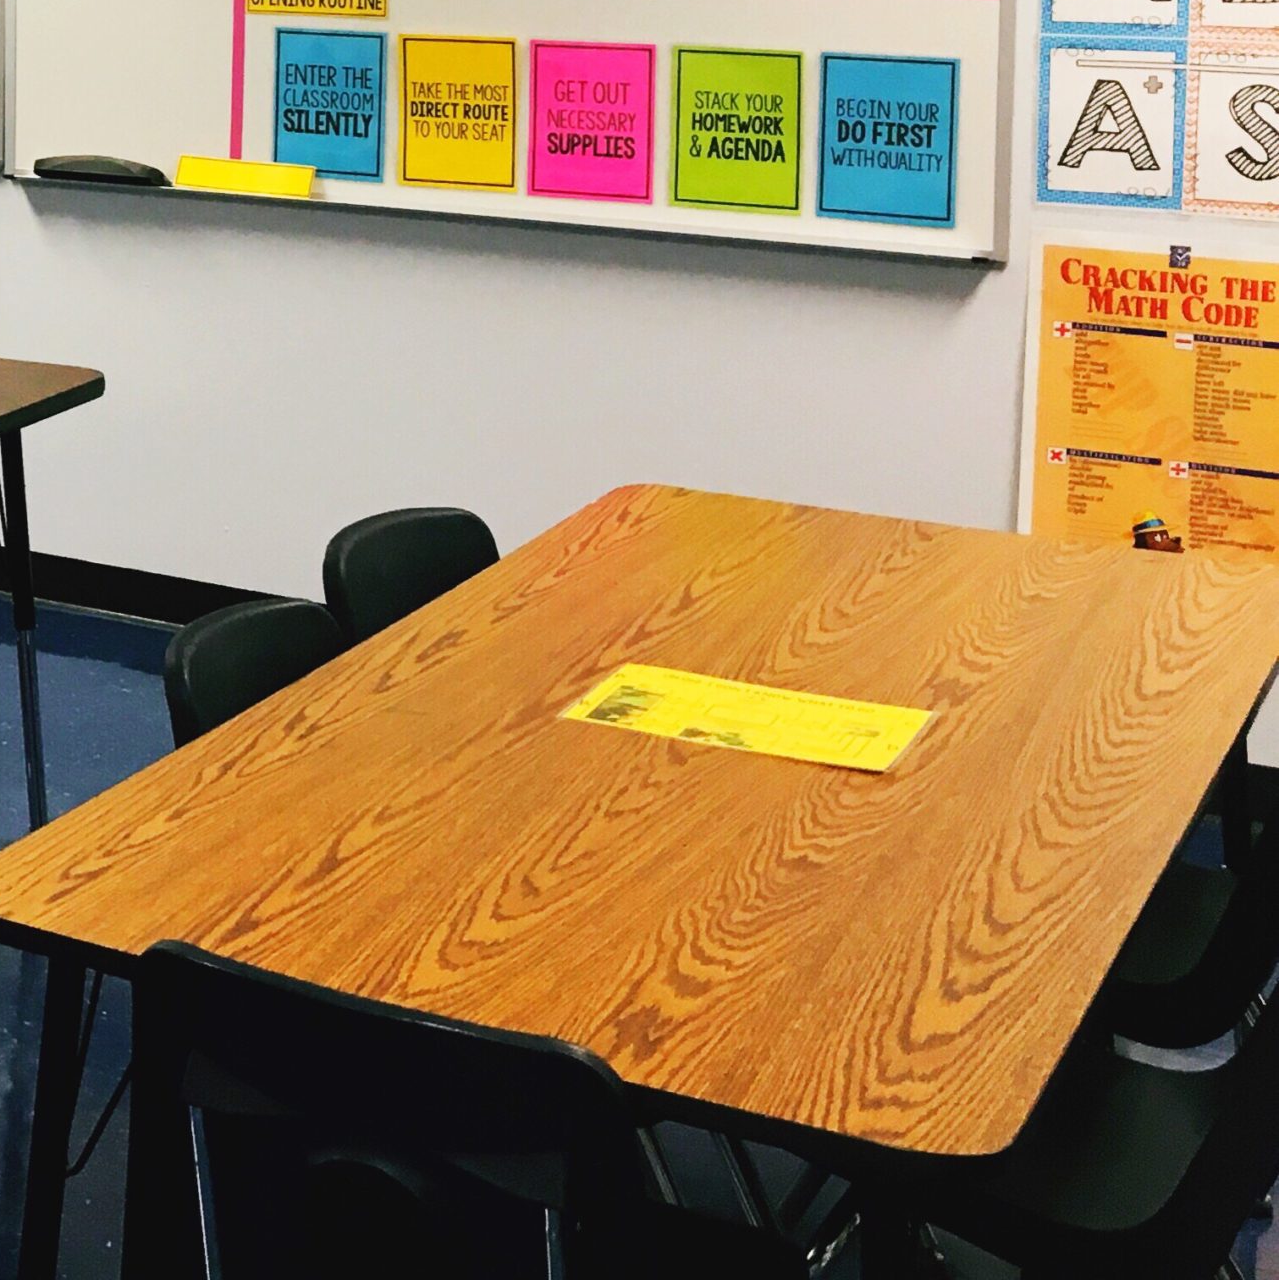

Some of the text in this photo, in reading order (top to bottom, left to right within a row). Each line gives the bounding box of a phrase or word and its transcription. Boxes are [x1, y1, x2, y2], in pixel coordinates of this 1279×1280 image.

[285, 63, 373, 90] ENTER THE
[283, 88, 374, 112] CLASSROOM
[411, 81, 509, 102] TAKE THE MOST
[554, 80, 631, 105] GET OUT
[694, 91, 783, 113] STACK YOUR
[283, 108, 373, 138] SILENTLY
[410, 100, 509, 121] DIRECT ROUTE
[546, 110, 637, 132] NECESSARY
[836, 98, 939, 123] BEGIN YOUR
[413, 120, 506, 142] TO YOUR SEAT
[691, 112, 784, 136] HOMEWORK
[837, 121, 937, 148] DO FIRST
[1057, 79, 1161, 171] A
[547, 132, 635, 160] SUPPLIES
[689, 134, 786, 163] & AGENDA
[831, 148, 943, 173] WITH QUALITY
[1060, 257, 1208, 296] CRACKING
[1221, 276, 1276, 302] THE
[1087, 286, 1168, 321] MATH
[1182, 295, 1259, 328] CODE
